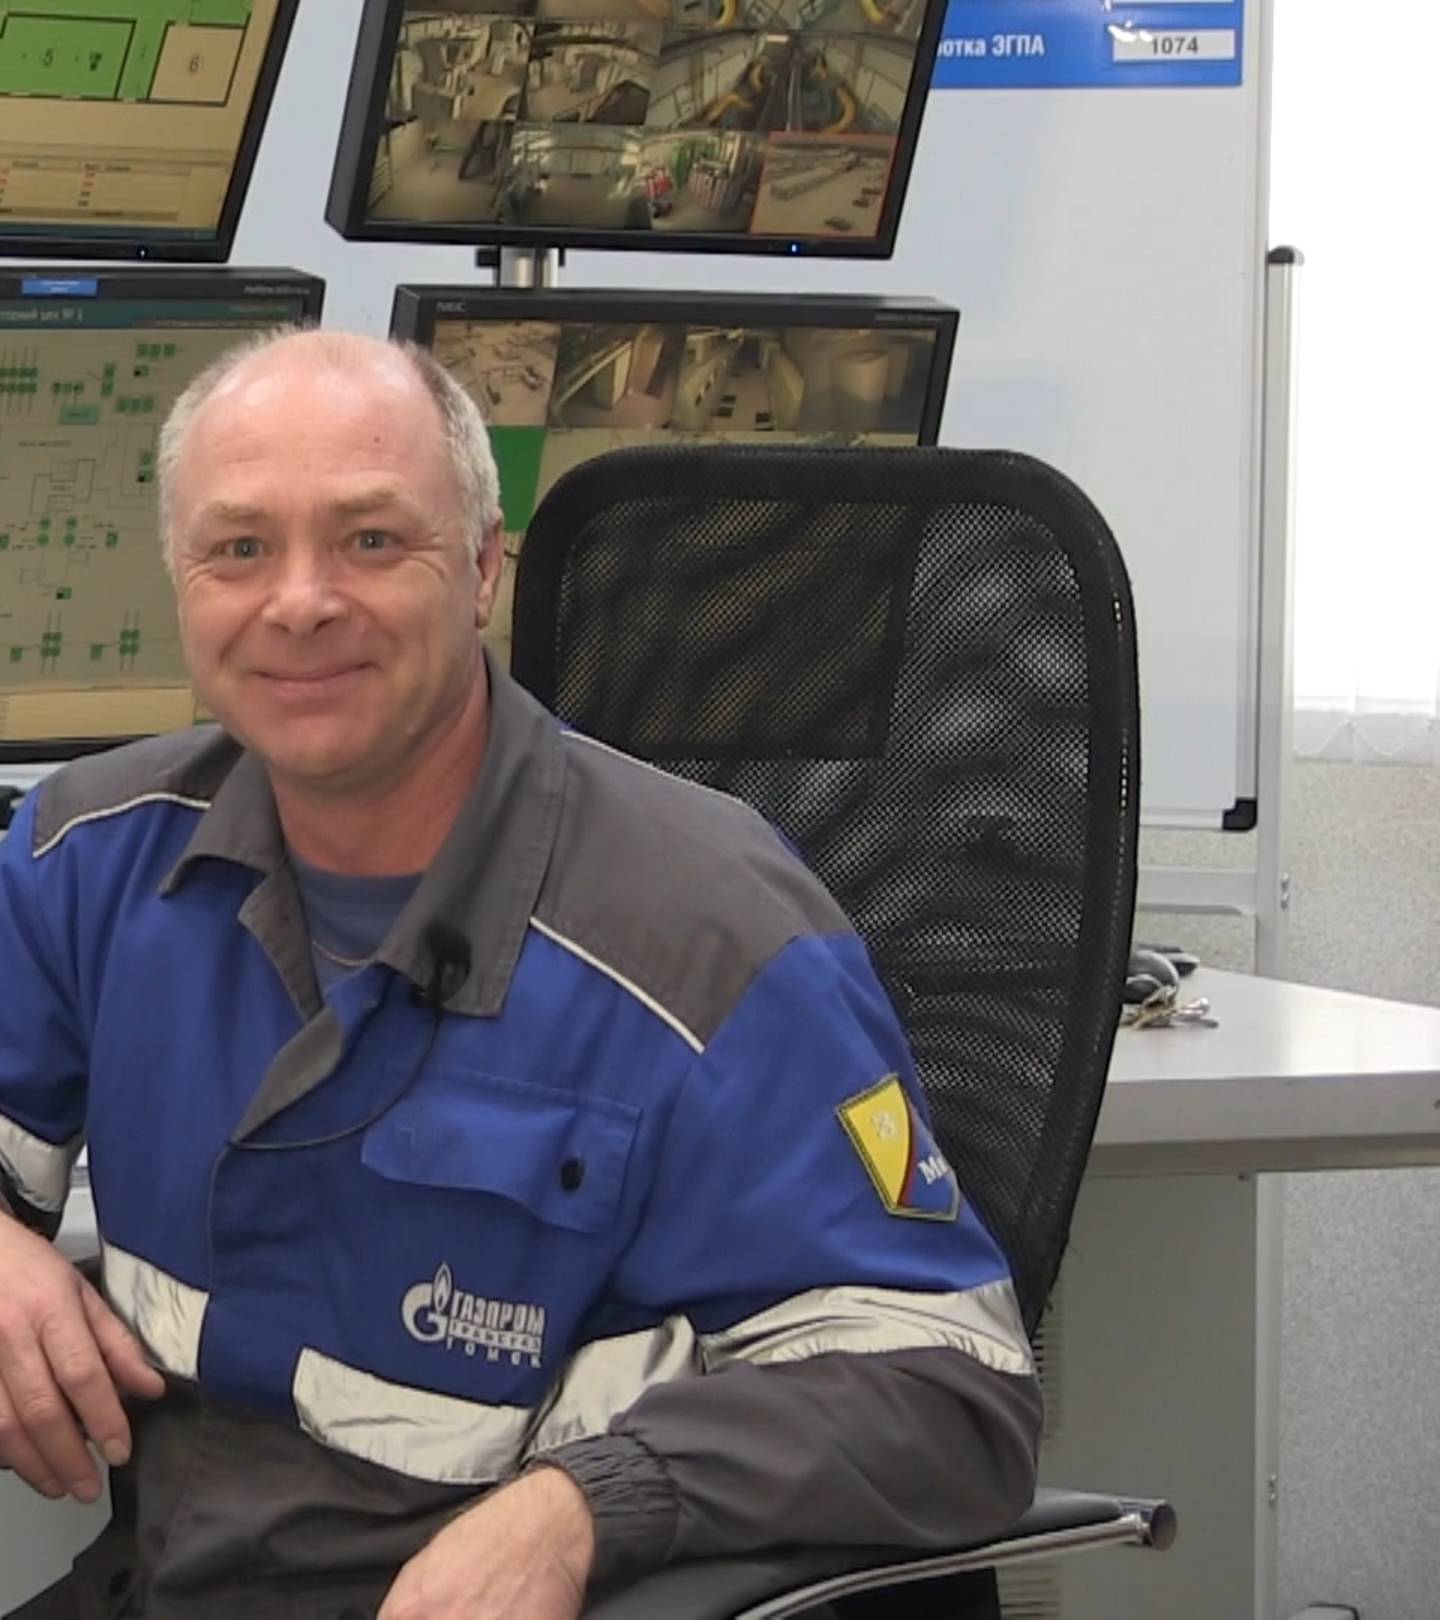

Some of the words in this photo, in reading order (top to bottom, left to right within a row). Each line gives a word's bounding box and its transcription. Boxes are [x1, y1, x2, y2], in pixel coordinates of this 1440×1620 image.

[992, 34, 1045, 57] ЭГПА
[1152, 36, 1199, 55] 1074
[188, 55, 200, 74] 6
[451, 1289, 545, 1337] ГАЗПРОМ
[447, 1336, 541, 1368] ТОМСК
